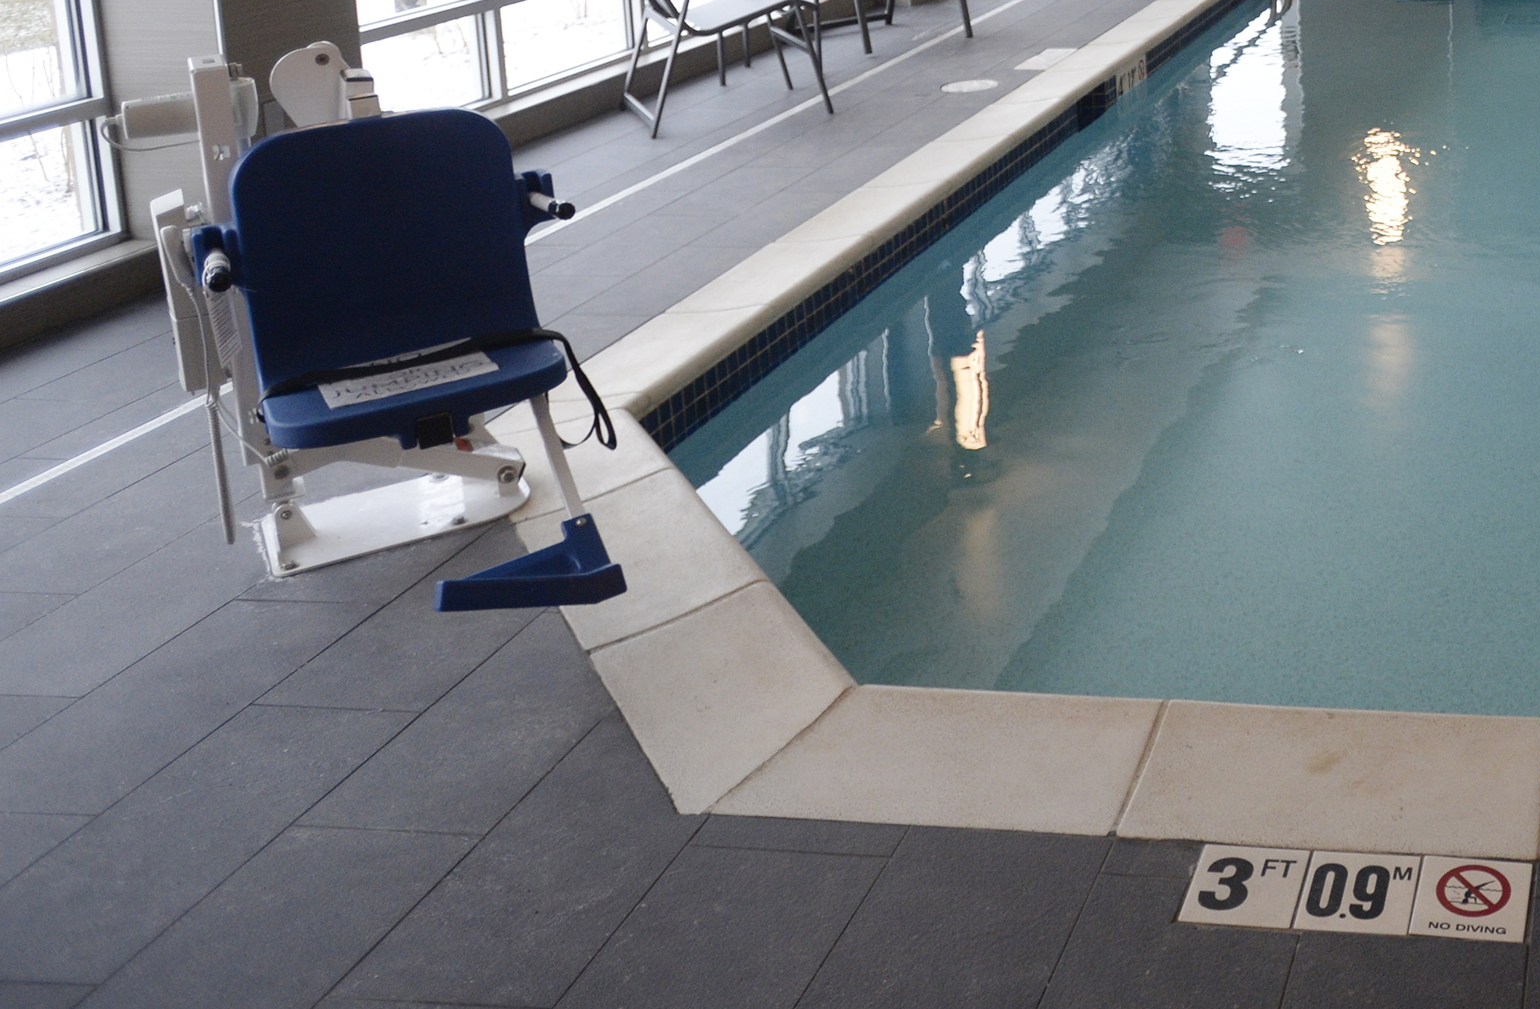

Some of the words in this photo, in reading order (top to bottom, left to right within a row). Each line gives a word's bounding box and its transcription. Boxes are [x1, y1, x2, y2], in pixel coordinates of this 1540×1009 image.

[1197, 857, 1255, 911] 3
[1260, 859, 1298, 879] FT
[1305, 863, 1390, 920] 0.9
[1392, 866, 1413, 881] M
[1427, 921, 1451, 931] NO
[1455, 923, 1507, 936] DIVING
